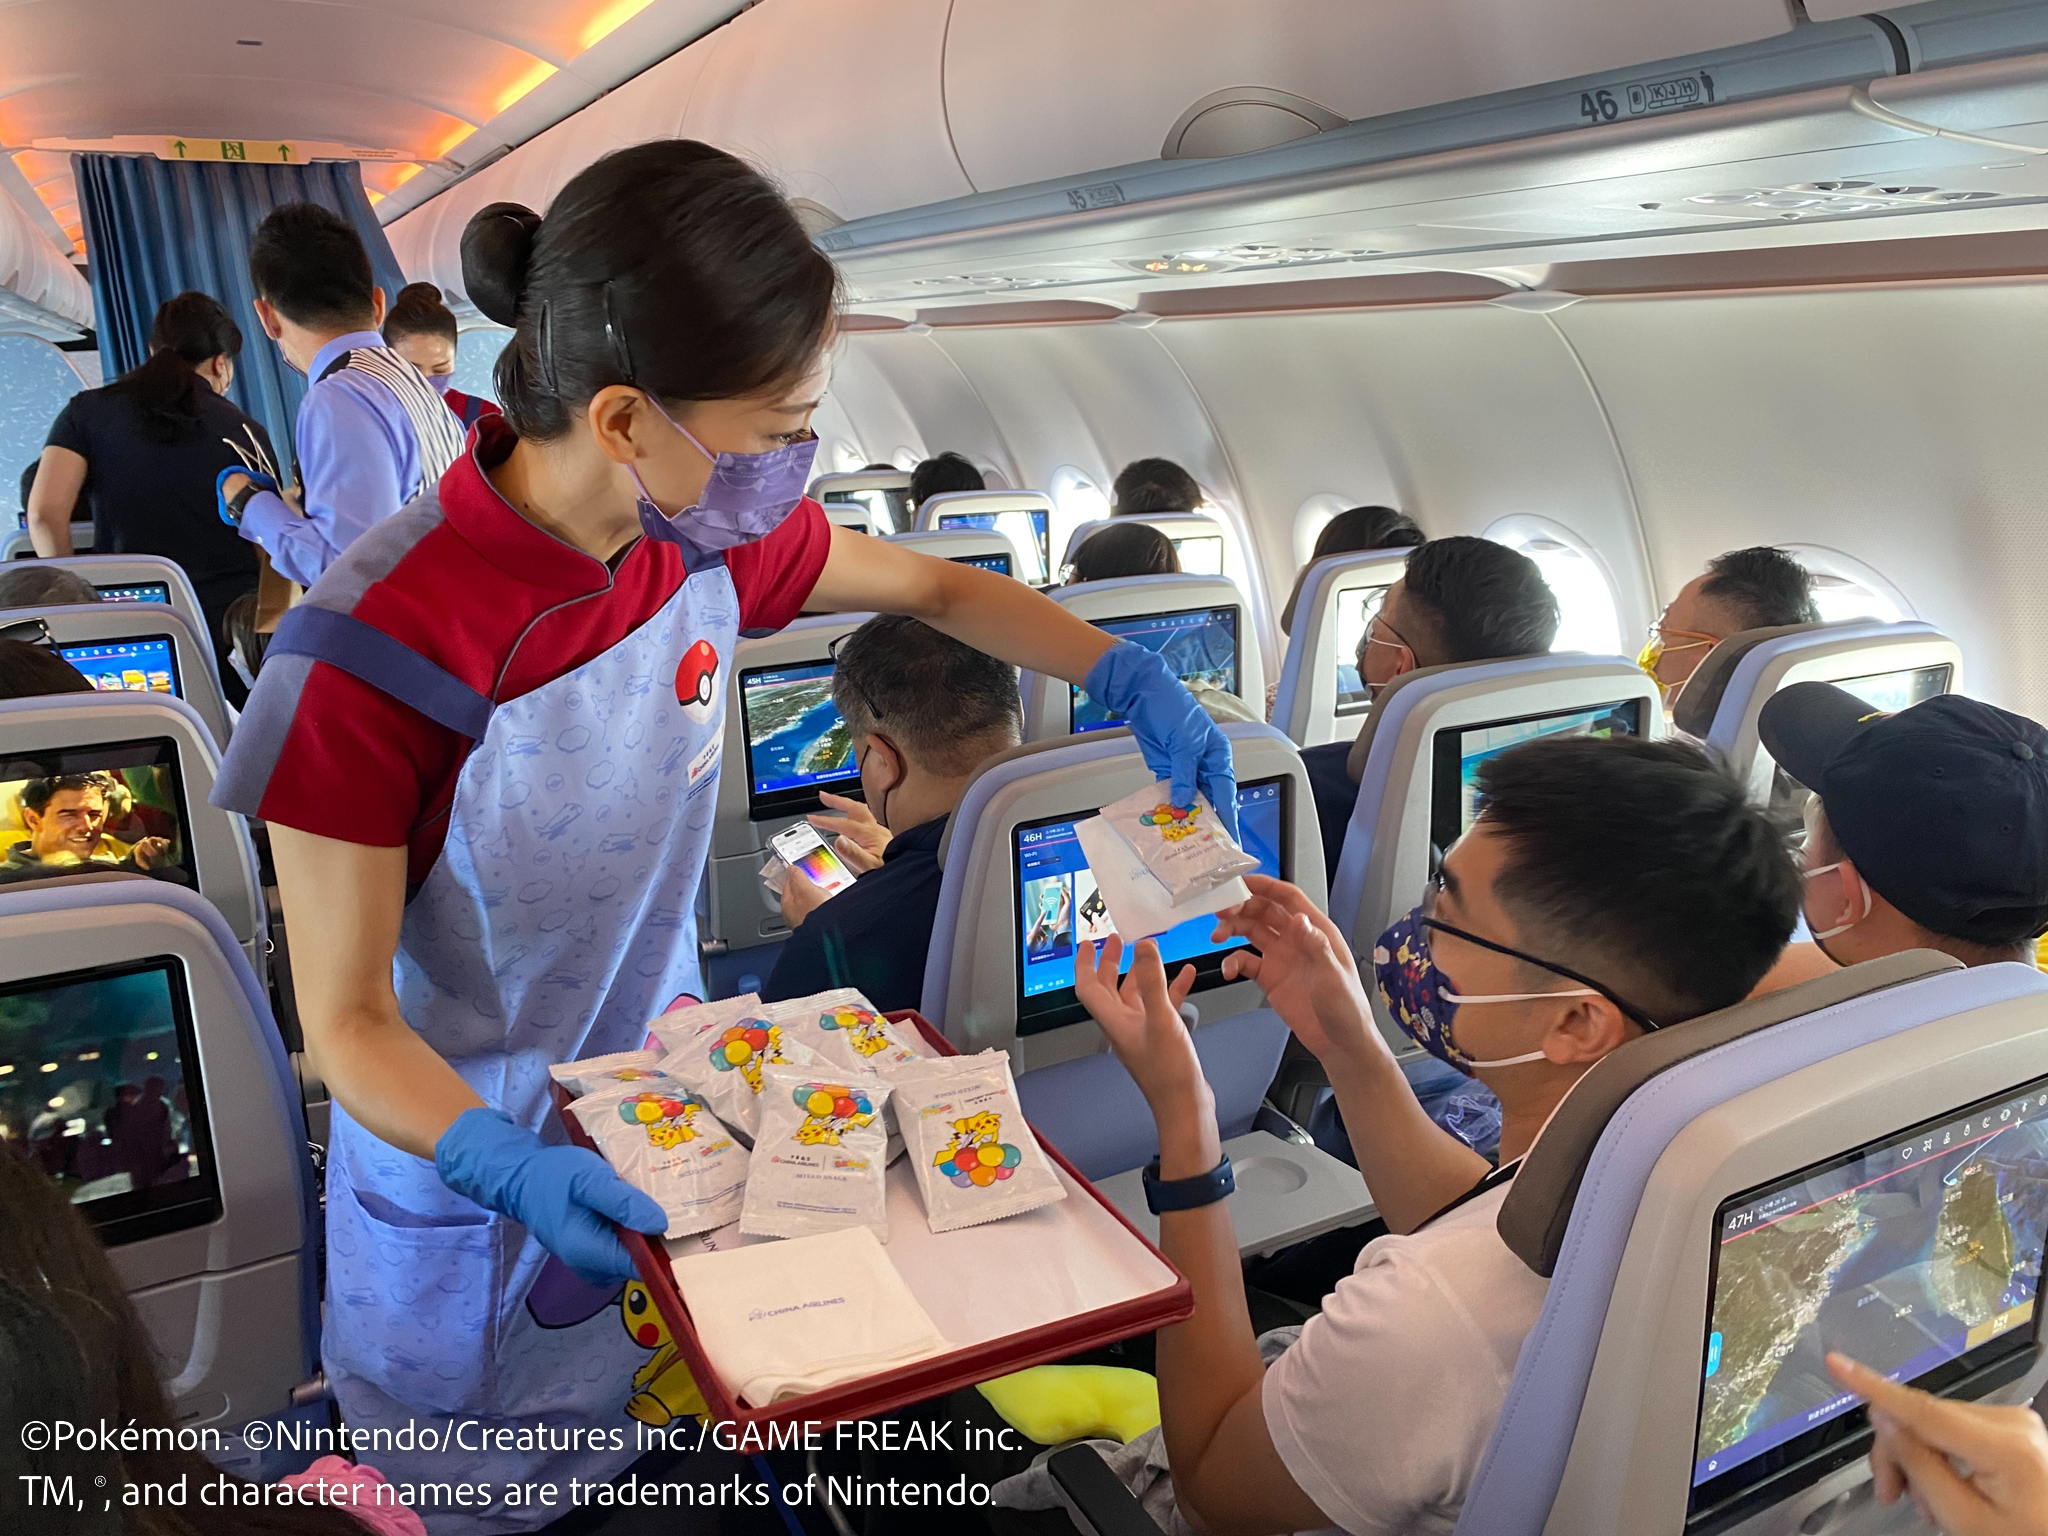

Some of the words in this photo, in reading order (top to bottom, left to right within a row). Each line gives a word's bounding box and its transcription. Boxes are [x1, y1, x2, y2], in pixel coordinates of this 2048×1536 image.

[1580, 89, 1619, 122] 46
[1066, 190, 1087, 209] 45
[747, 677, 762, 685] 45H
[1023, 832, 1043, 842] 46H
[1727, 1210, 1754, 1230] 47H
[699, 1231, 719, 1252] RLIN
[767, 1305, 801, 1317] CHINA
[802, 1297, 845, 1309] AIRLINES
